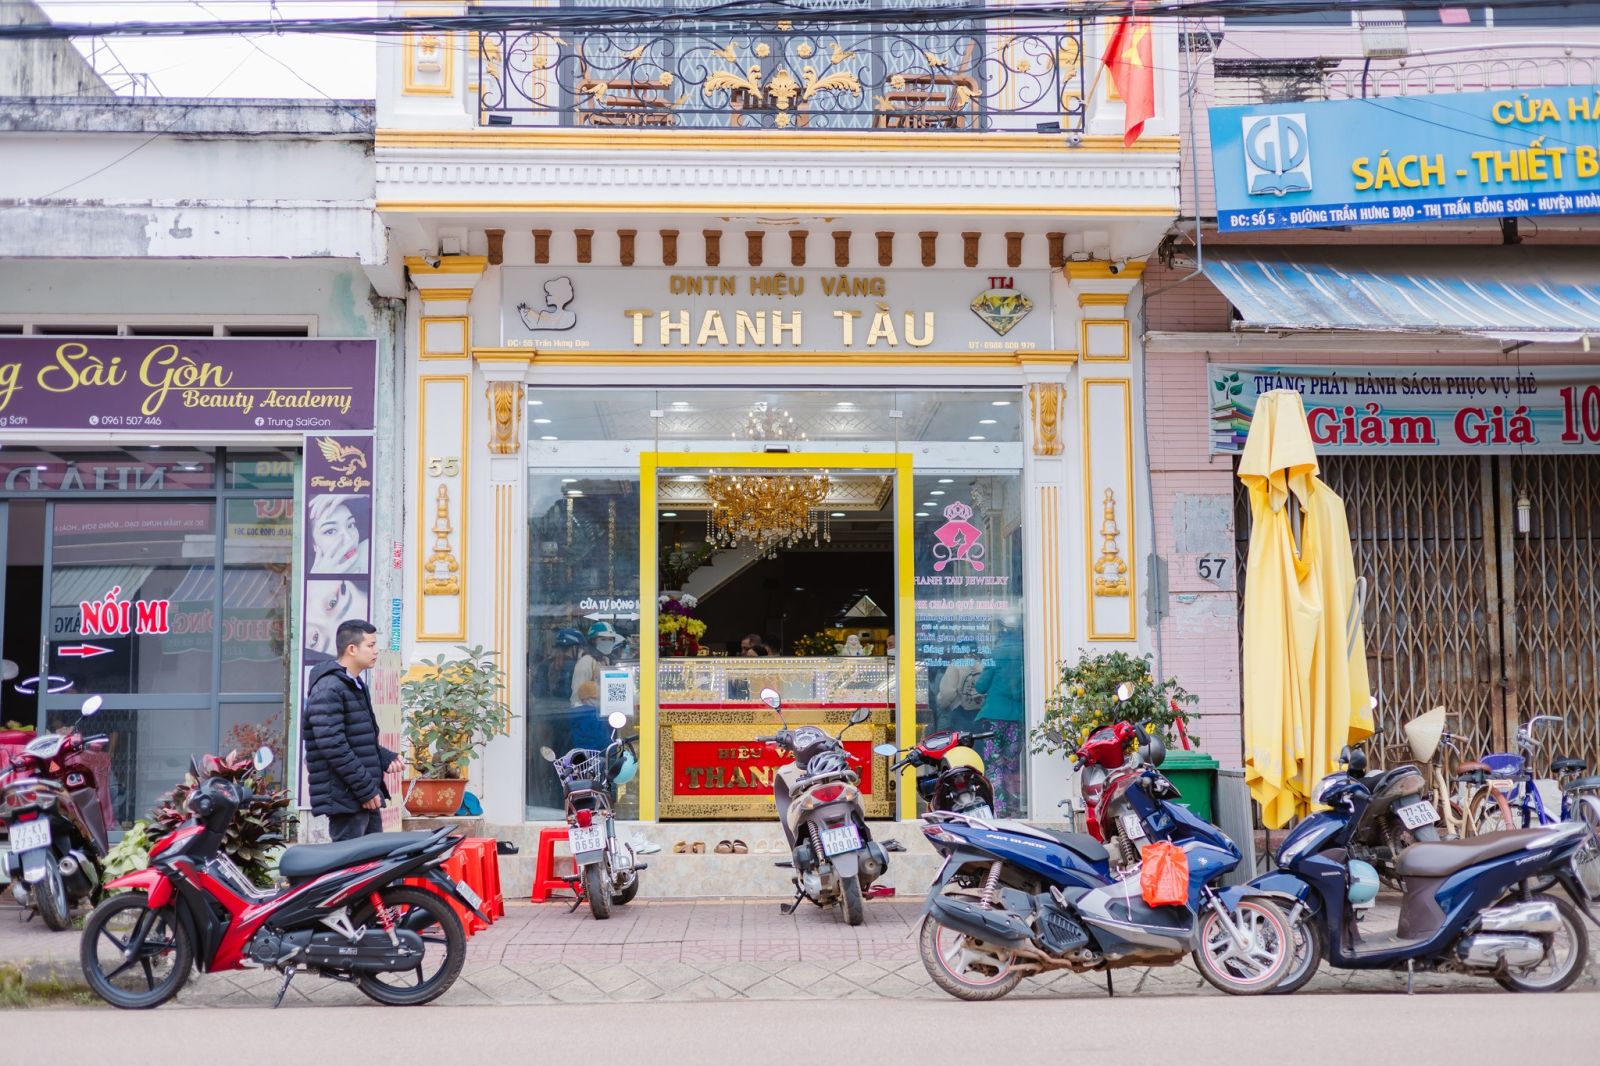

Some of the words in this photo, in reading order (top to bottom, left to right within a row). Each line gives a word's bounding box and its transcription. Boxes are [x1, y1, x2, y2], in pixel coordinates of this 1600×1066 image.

[1492, 93, 1561, 124] CỬA
[1351, 149, 1446, 191] SÁCH
[1471, 136, 1568, 183] THIẾT
[1230, 214, 1250, 227] ĐC:
[1251, 209, 1266, 225] SỐ
[1268, 213, 1275, 225] 5
[1290, 209, 1328, 224] ĐƯỜNG
[1329, 204, 1358, 222] TRẦN
[1360, 205, 1390, 220] HƯNG
[1393, 205, 1415, 221] ĐẠO
[1423, 204, 1442, 219] THỊ
[1442, 198, 1471, 216] TRẤN
[1474, 196, 1504, 213] BỒNG
[1507, 198, 1529, 212] SƠN
[1538, 193, 1573, 213] HUYỆN
[669, 274, 735, 295] DNTN
[750, 272, 805, 299] HIỆU
[821, 274, 886, 296] VÀNG
[987, 276, 1014, 289] TTJ
[624, 309, 802, 346] THANH
[833, 301, 935, 347] TÀU
[37, 342, 127, 392] Sài
[139, 344, 233, 416] Gòn
[1254, 371, 1306, 395] THÁNG
[1310, 371, 1350, 395] PHÁT
[1354, 371, 1397, 395] HÀNH
[1402, 371, 1442, 395] SÁCH
[1446, 376, 1487, 399] PHỤC
[1490, 376, 1510, 399] VỤ
[1515, 371, 1538, 395] HÈ
[182, 389, 255, 415] Beauty
[259, 389, 352, 415] Academy
[9, 416, 28, 425] Sơn
[101, 416, 123, 426] 0961
[125, 416, 143, 426] 507
[144, 416, 162, 426] 446
[267, 417, 294, 427] Trung
[295, 417, 331, 427] SaiGon
[1306, 402, 1438, 444] Giảm
[1454, 405, 1538, 445] Giá
[428, 456, 459, 478] 55
[1199, 558, 1227, 578] 57
[80, 586, 131, 635] NỐI
[135, 600, 169, 635] MI
[579, 597, 599, 610] CỬA
[599, 598, 610, 611] TỰ
[611, 598, 635, 611] ĐỘNG
